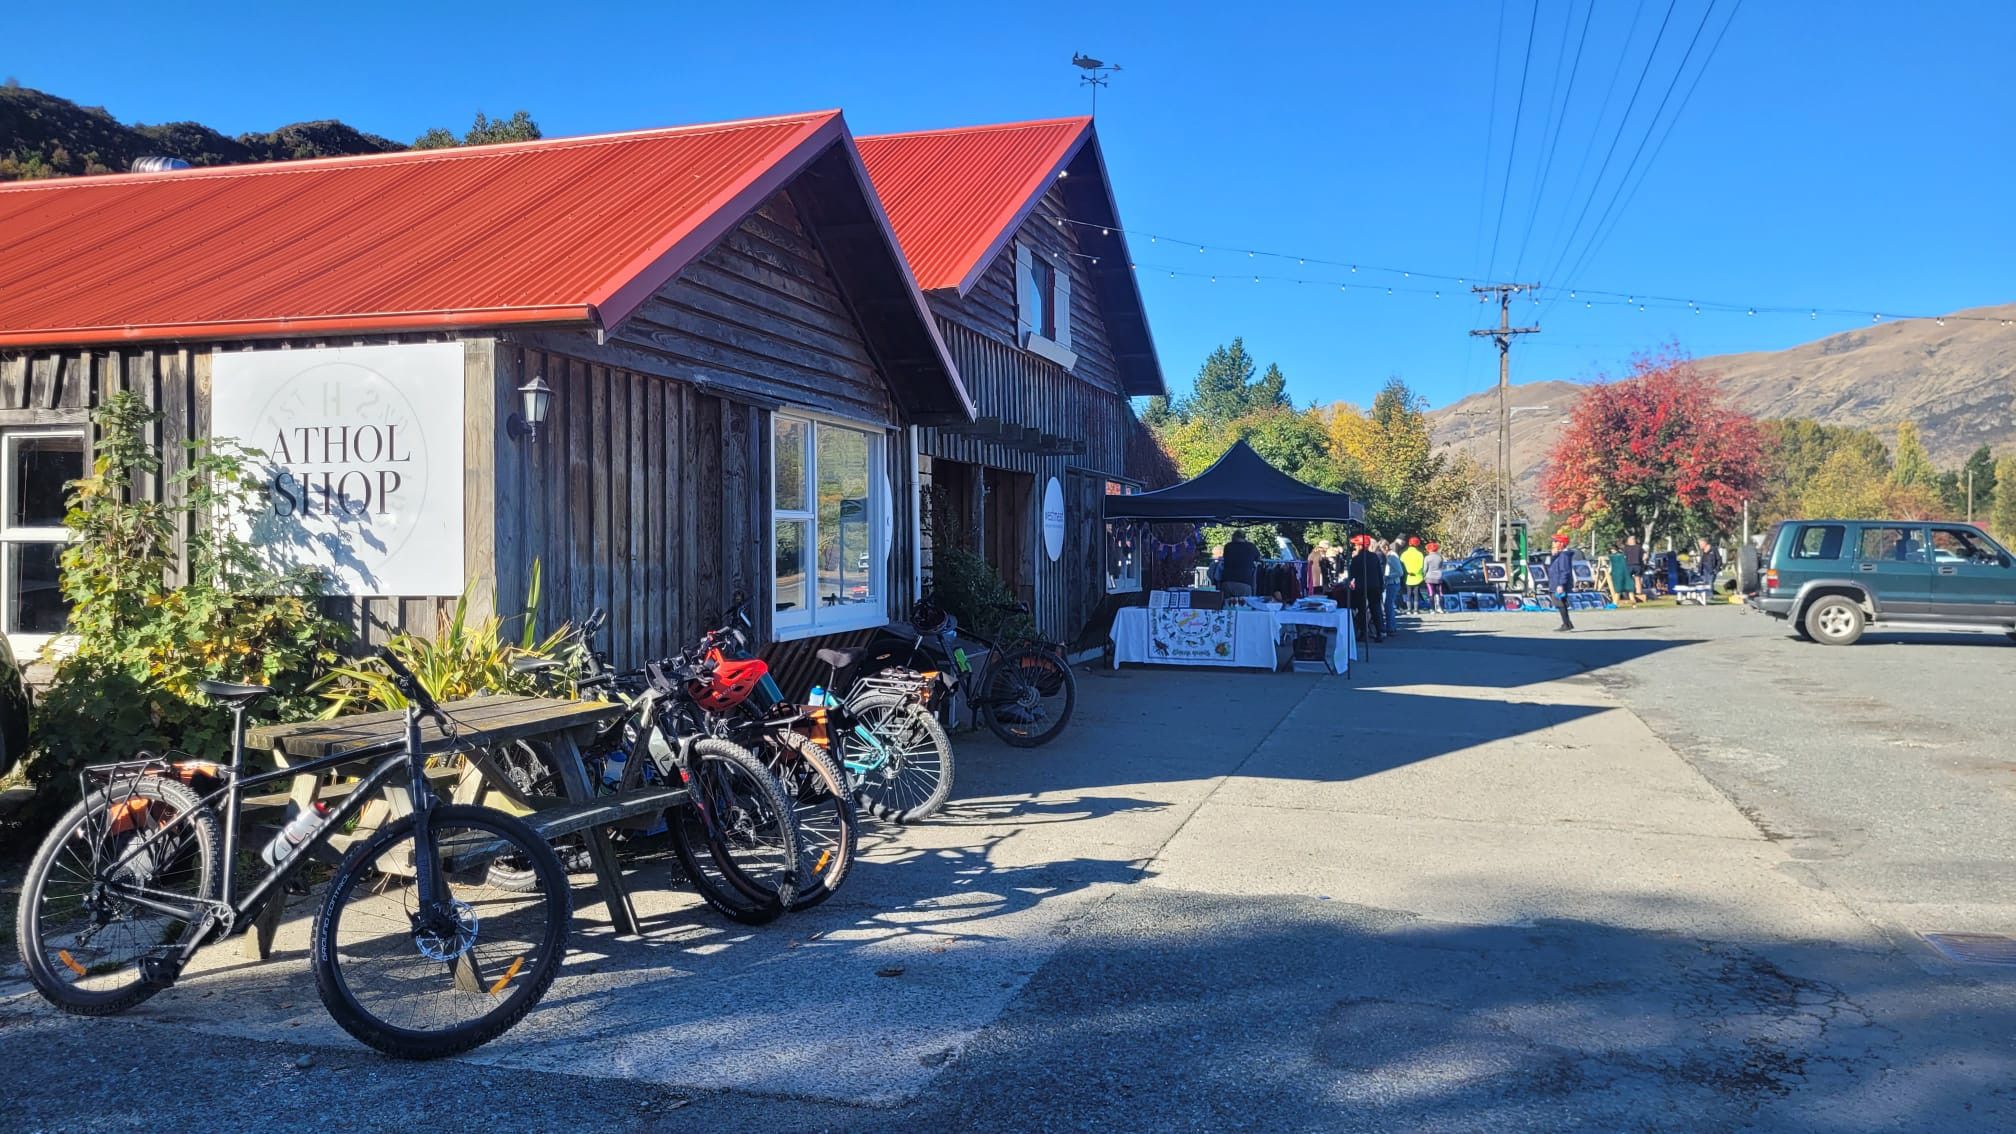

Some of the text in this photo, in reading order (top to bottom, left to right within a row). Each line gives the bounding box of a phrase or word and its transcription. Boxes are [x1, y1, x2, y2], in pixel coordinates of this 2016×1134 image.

[269, 424, 411, 465] ATHOL
[273, 470, 402, 518] SHOP
[326, 872, 351, 917] CONTROL
